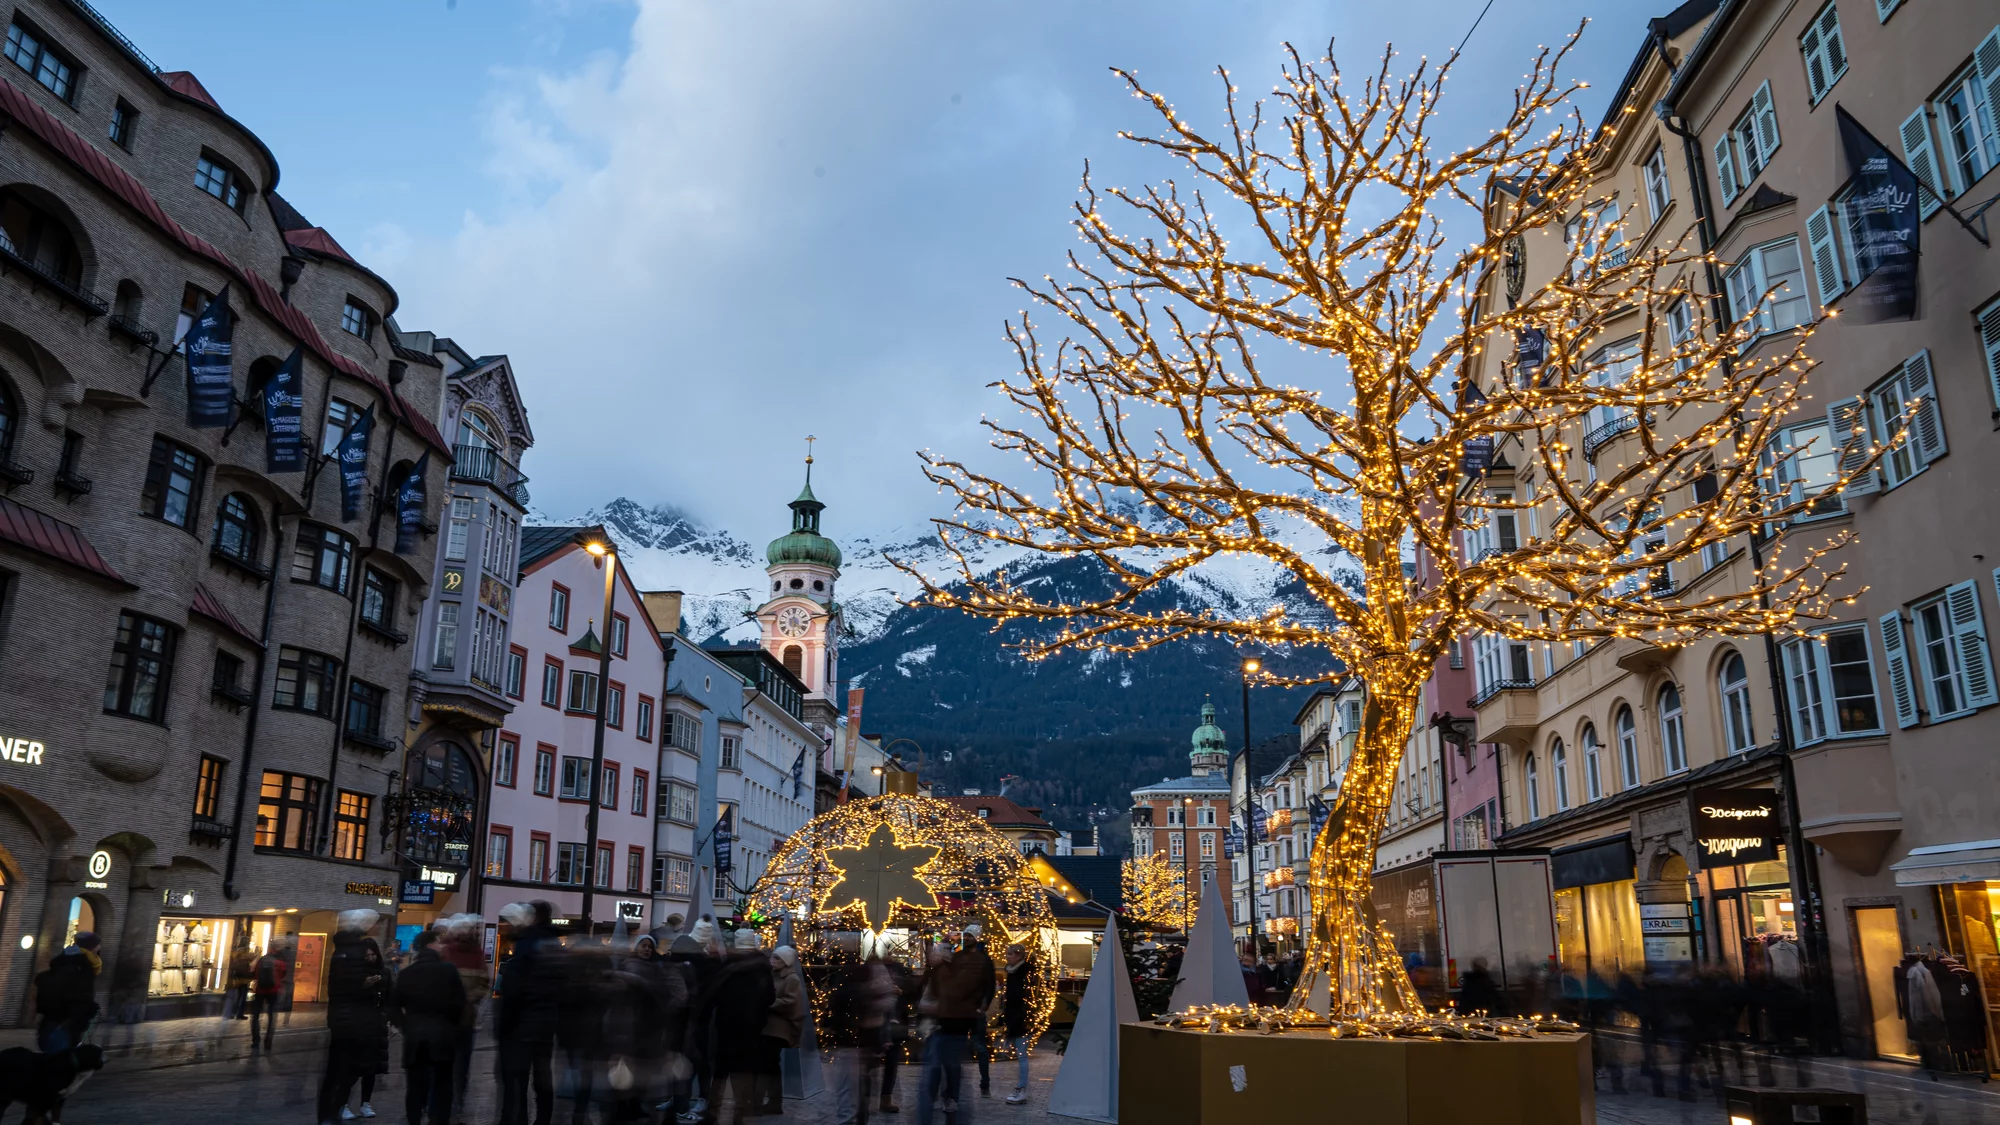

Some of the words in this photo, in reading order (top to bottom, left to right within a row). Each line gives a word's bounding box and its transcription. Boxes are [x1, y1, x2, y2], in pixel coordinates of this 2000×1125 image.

[0, 736, 44, 765] NER
[1700, 805, 1772, 820] Weigand
[431, 870, 456, 885] mara
[1648, 920, 1672, 928] KRAL
